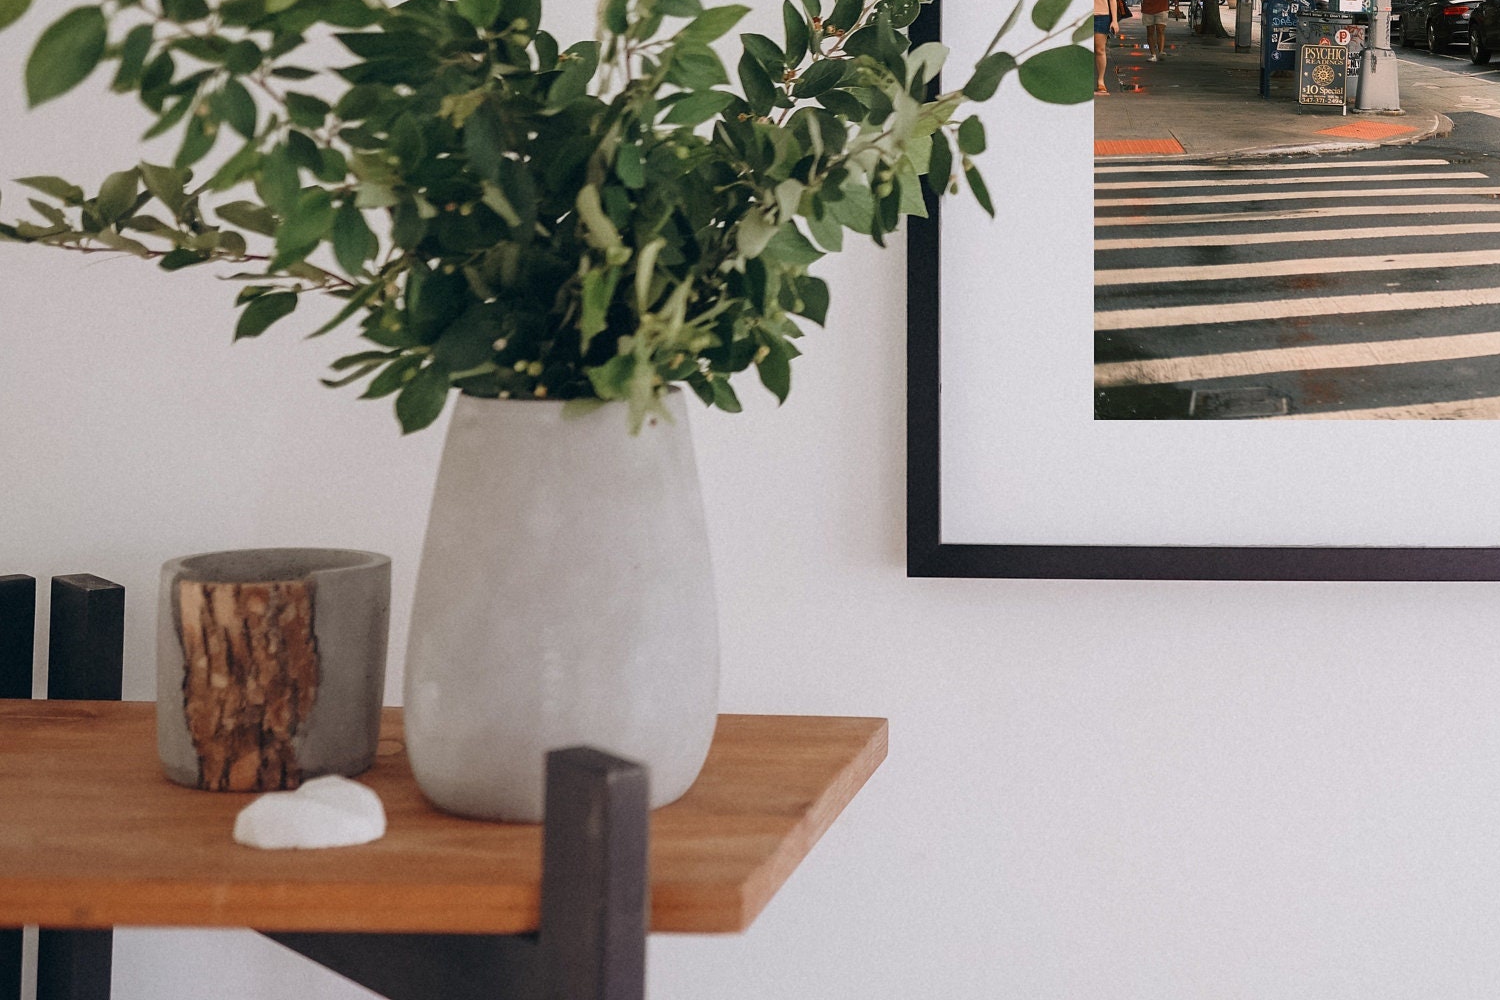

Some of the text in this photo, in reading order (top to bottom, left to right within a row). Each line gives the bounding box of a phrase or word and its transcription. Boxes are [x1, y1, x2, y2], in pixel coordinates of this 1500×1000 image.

[1305, 48, 1345, 60] PSYCHIC
[1302, 85, 1343, 95] $10 Special
